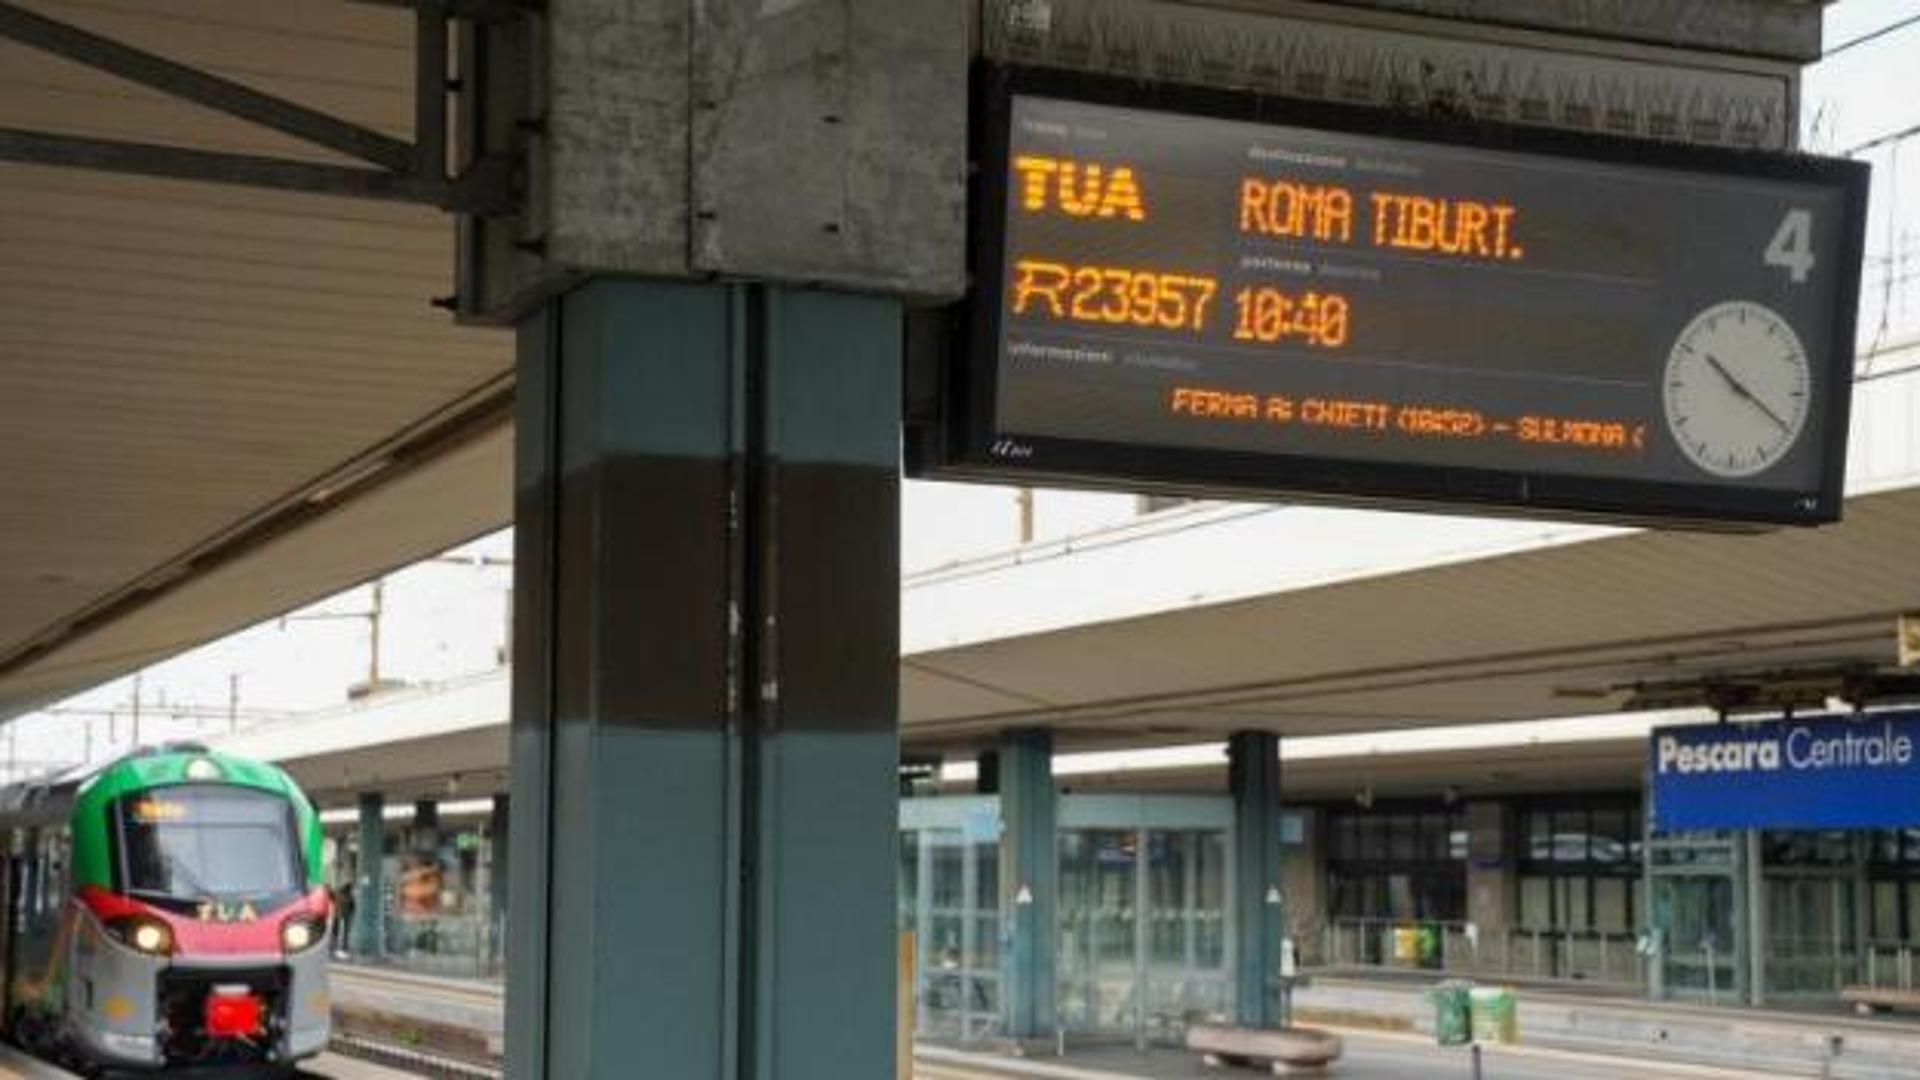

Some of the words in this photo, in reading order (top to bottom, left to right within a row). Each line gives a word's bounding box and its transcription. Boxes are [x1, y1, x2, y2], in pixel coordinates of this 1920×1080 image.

[1014, 155, 1145, 221] TUA
[1240, 177, 1350, 242] ROMA
[1371, 191, 1524, 259] TIBURT.
[1764, 208, 1815, 282] 4
[1233, 286, 1349, 347] 10:40
[1172, 386, 1258, 419] FERMA
[1520, 416, 1624, 448] SULMONA
[1658, 735, 1780, 773] Pescara
[1786, 722, 1912, 768] Centrale
[196, 903, 256, 921] TUA
